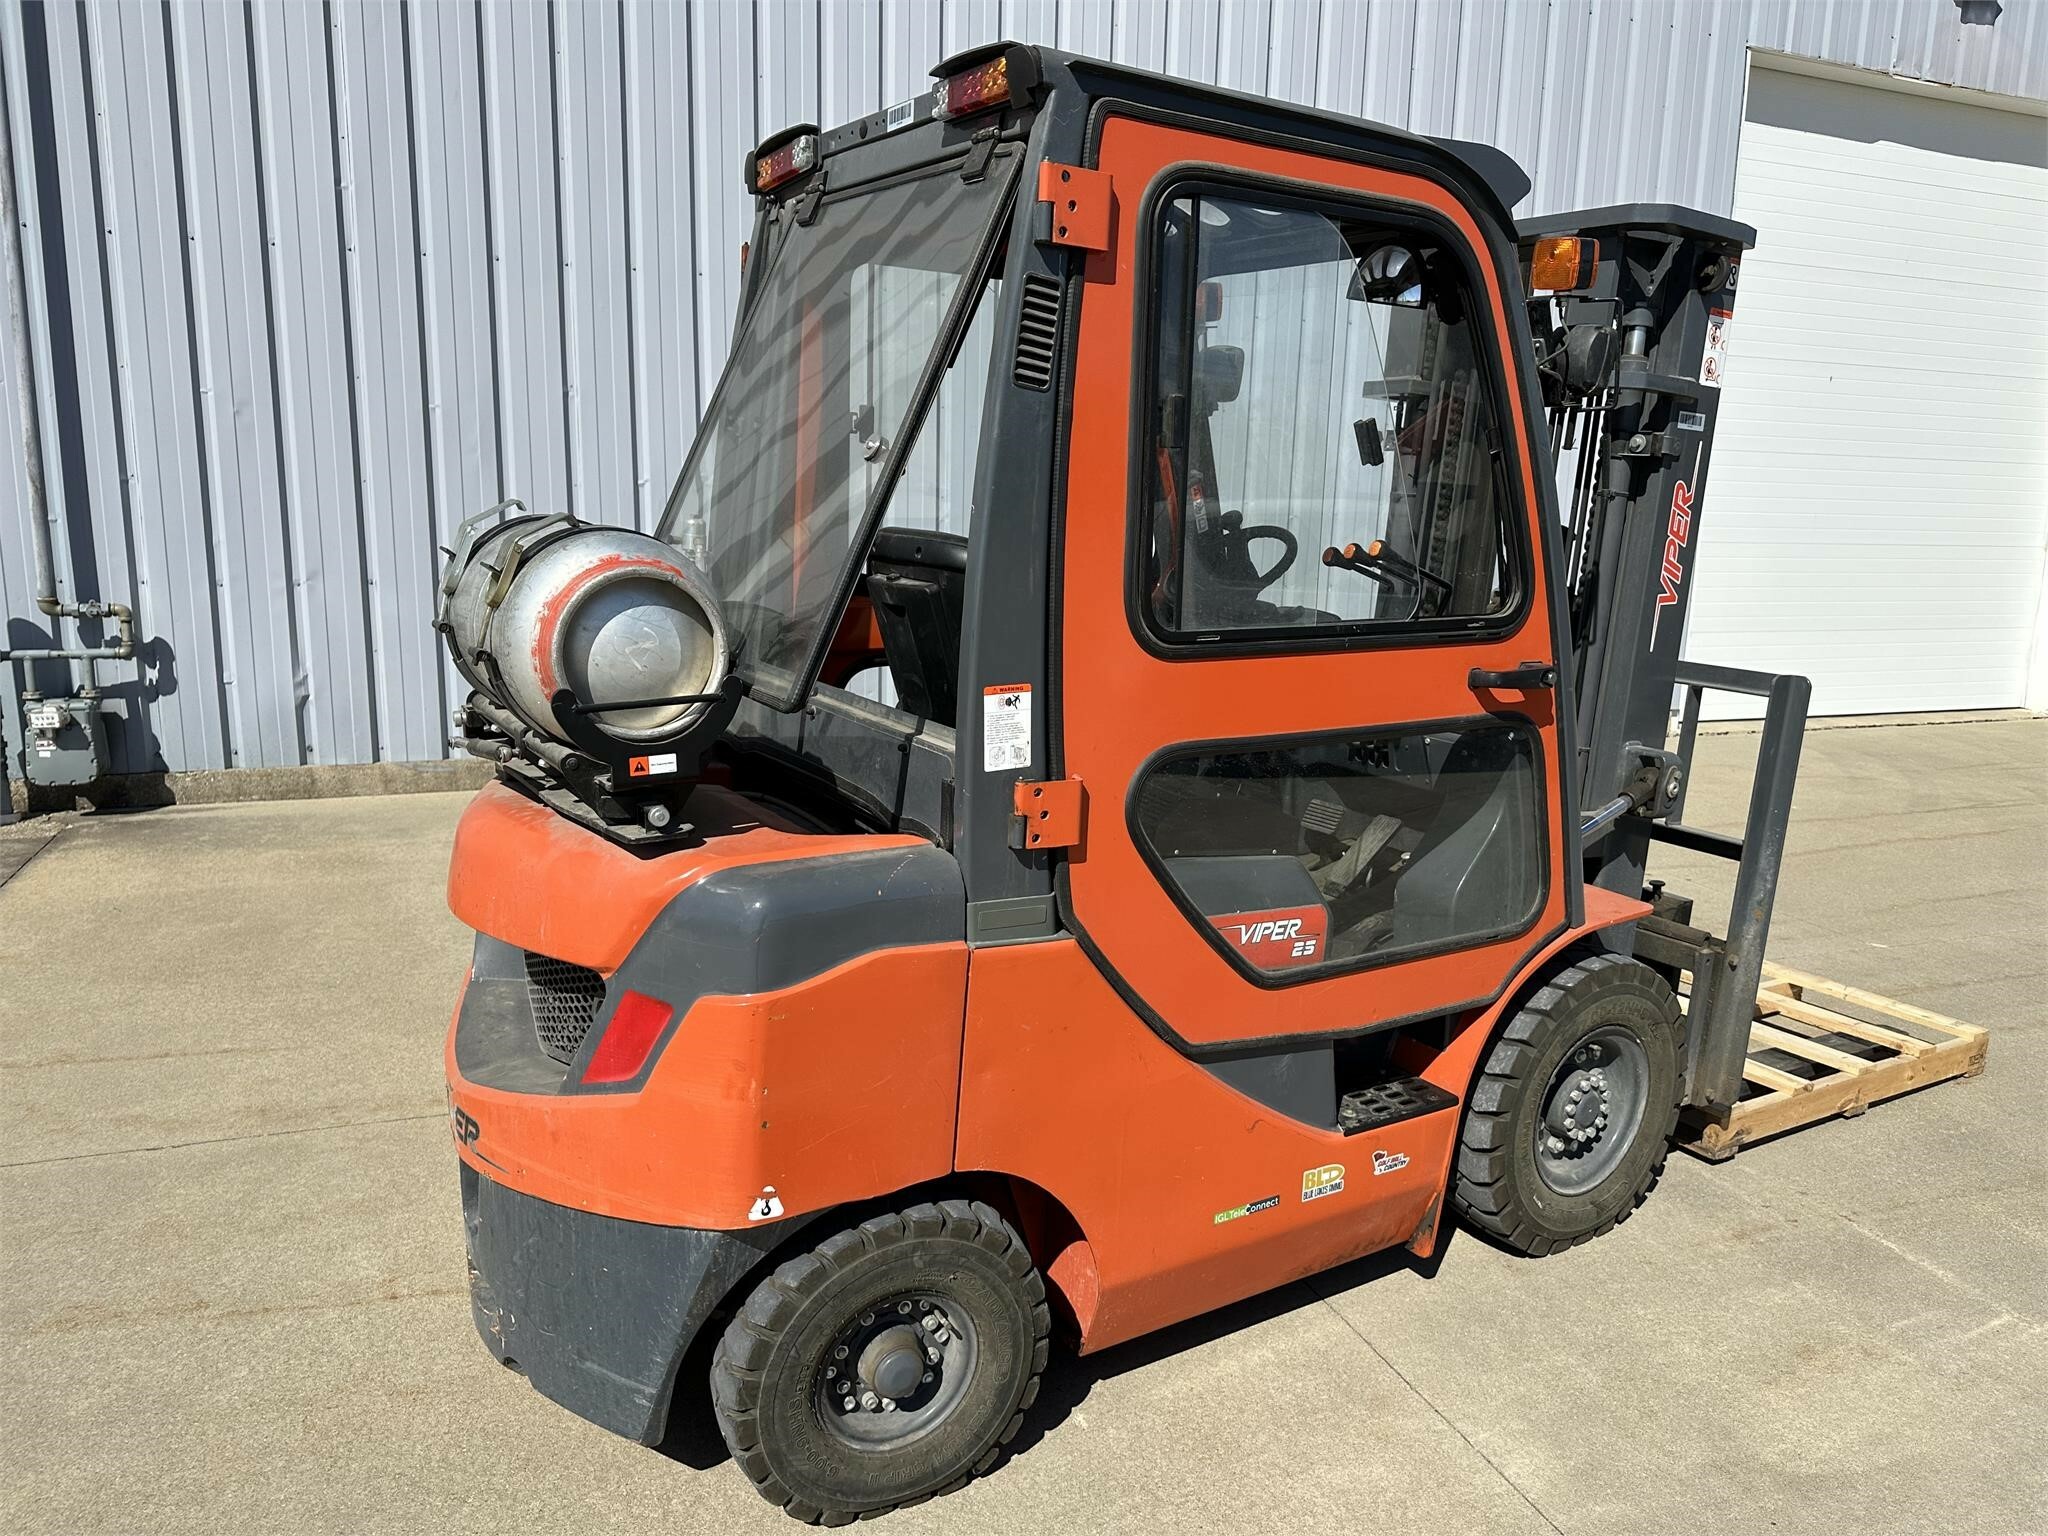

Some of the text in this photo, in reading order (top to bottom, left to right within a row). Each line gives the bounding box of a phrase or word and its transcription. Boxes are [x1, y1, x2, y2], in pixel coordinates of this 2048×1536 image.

[1657, 480, 1694, 605] VIPER
[1000, 685, 1024, 693] WARNING
[1239, 919, 1303, 945] VIPER
[1291, 939, 1317, 957] 25
[1214, 1212, 1229, 1225] IGL
